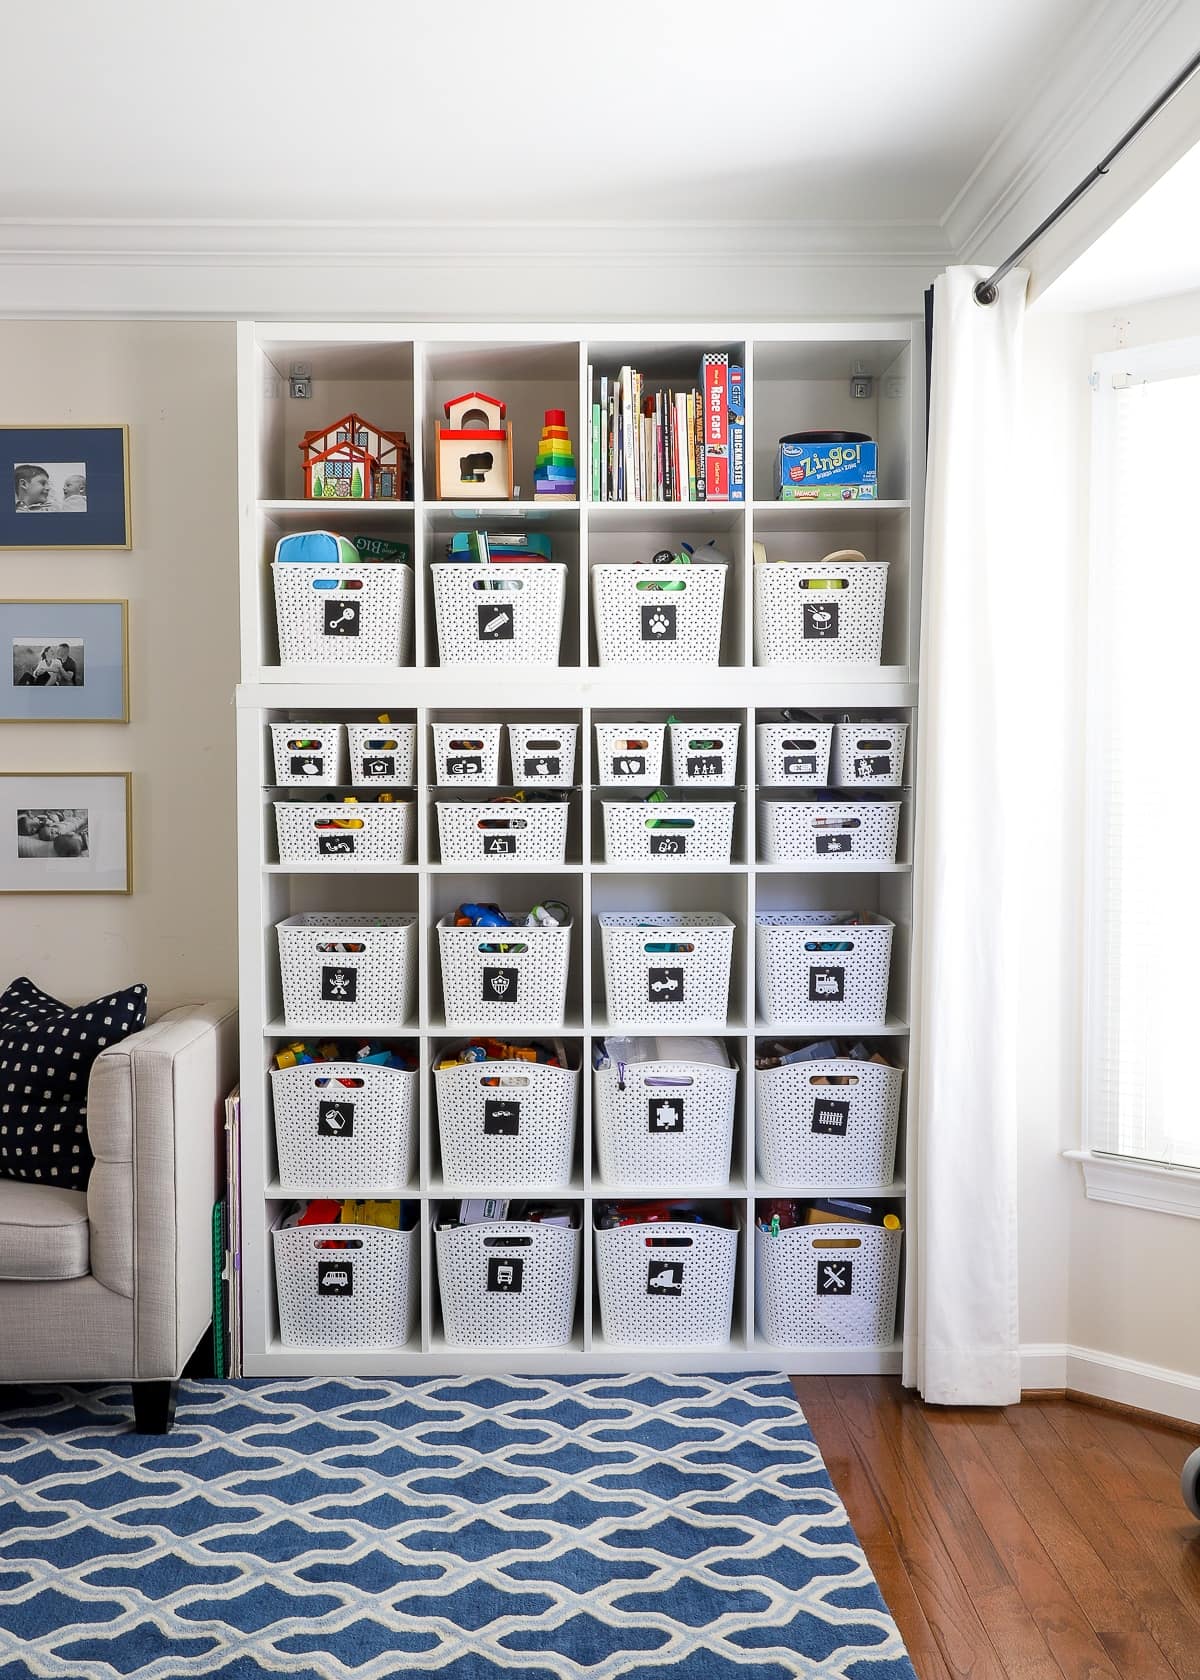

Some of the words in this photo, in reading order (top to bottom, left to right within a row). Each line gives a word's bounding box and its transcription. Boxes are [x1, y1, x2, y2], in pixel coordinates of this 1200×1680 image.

[695, 392, 703, 417] STAR
[711, 386, 723, 412] Race
[732, 385, 741, 407] CITY
[711, 415, 721, 439] cars
[734, 428, 743, 485] BRICKMASTER
[799, 444, 861, 478] Zingo!
[794, 488, 820, 497] MEMORY
[356, 538, 381, 554] BIG
